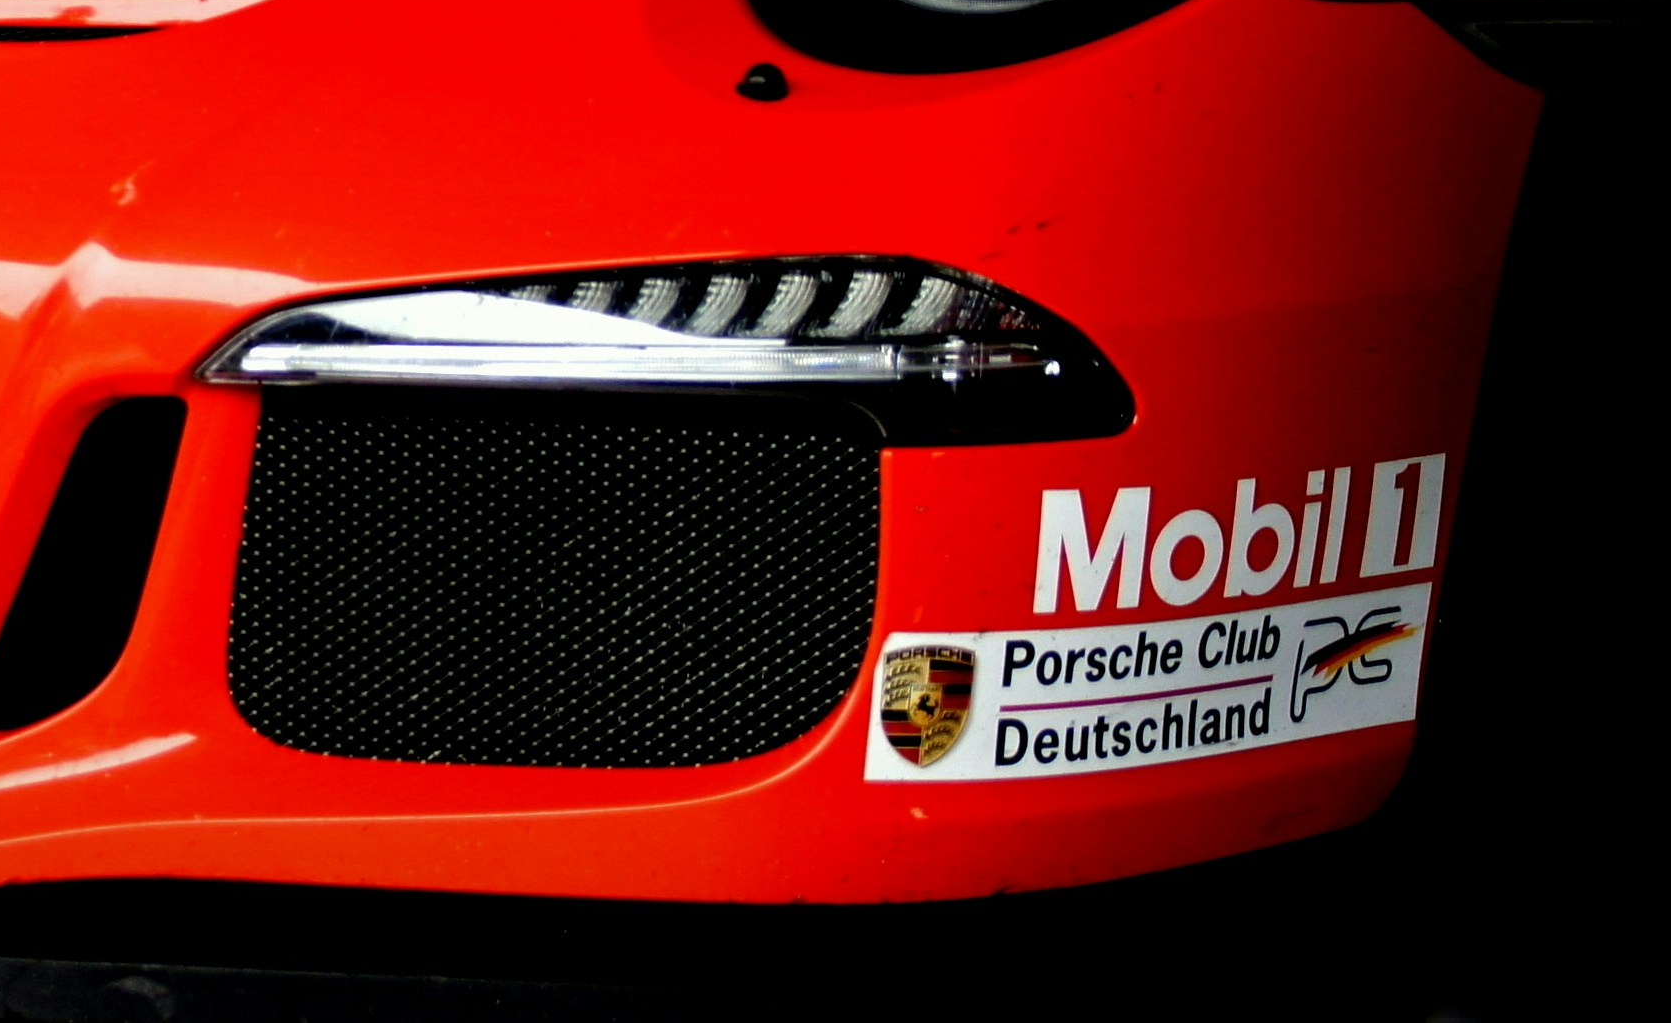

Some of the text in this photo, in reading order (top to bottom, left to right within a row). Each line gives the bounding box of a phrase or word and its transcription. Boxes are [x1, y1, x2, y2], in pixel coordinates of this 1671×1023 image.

[1033, 466, 1351, 614] Mobil
[886, 647, 974, 663] PORSCHE
[1002, 615, 1281, 688] Porsche Club
[995, 688, 1272, 766] Deutschland
